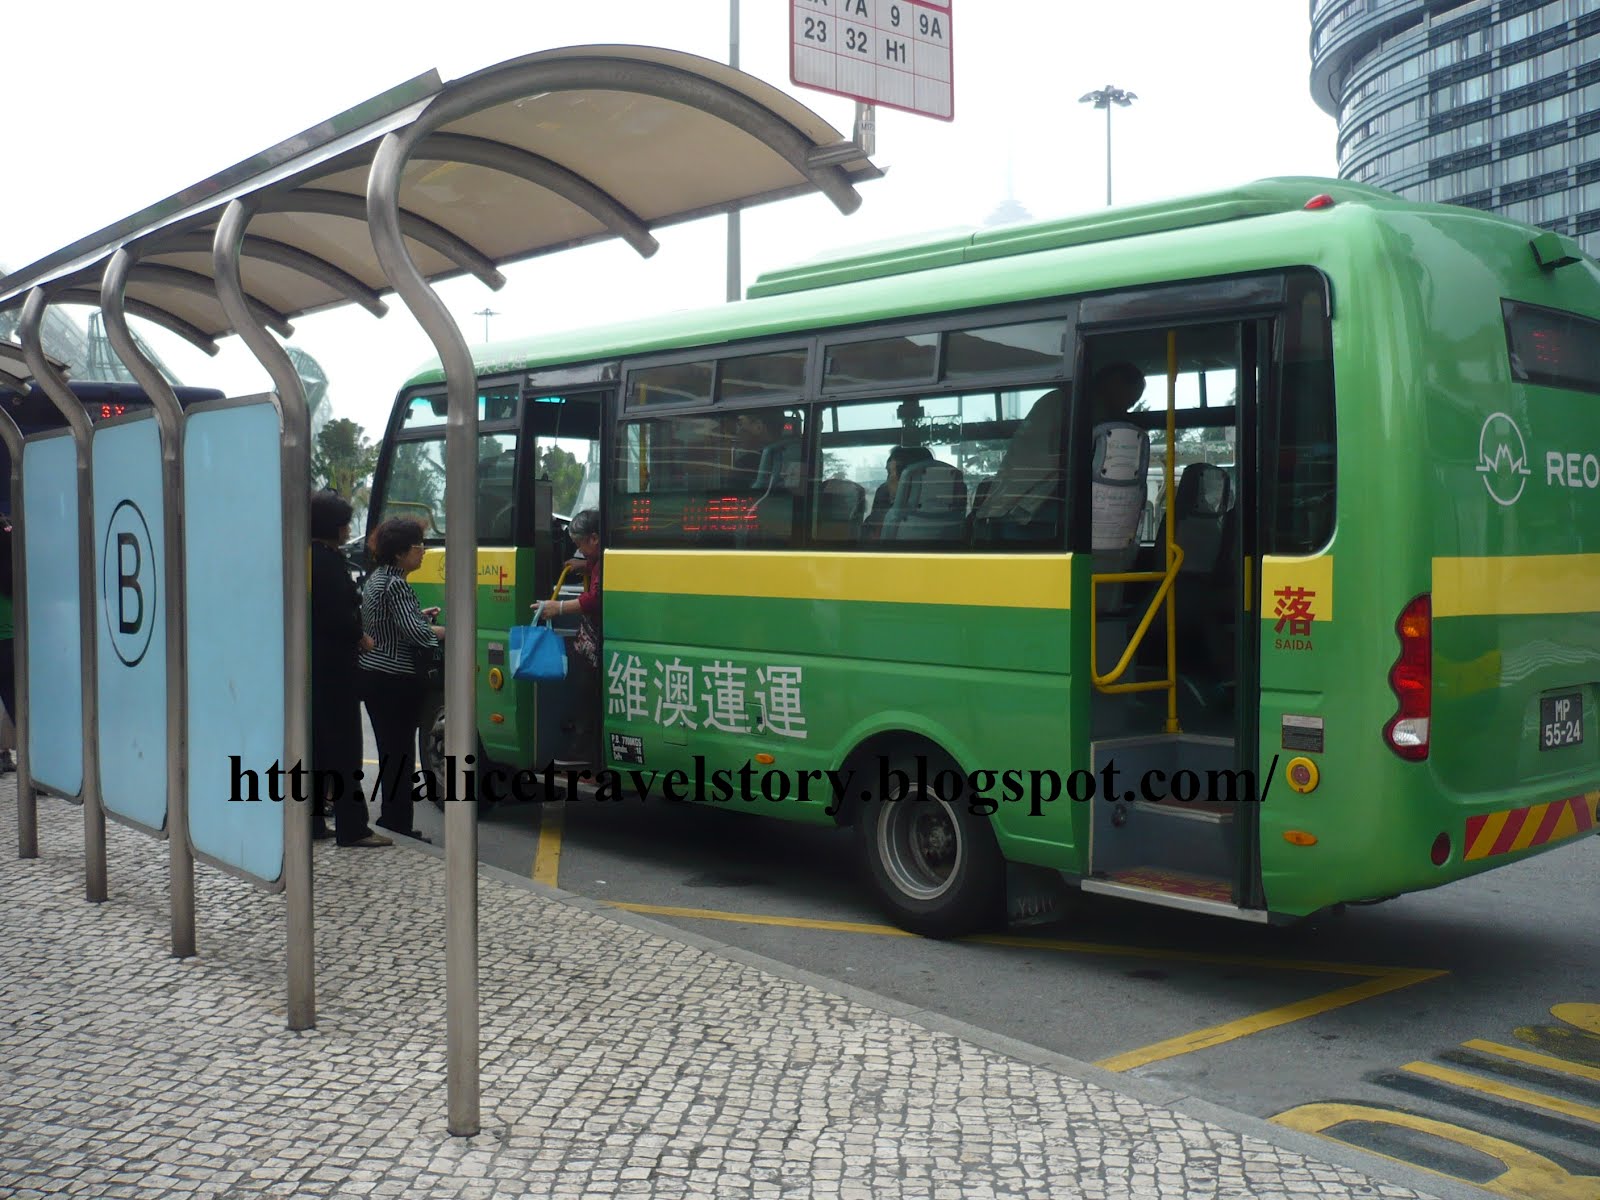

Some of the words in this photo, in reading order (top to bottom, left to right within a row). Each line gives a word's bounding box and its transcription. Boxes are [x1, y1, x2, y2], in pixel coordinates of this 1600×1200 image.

[890, 5, 901, 27] 9
[919, 14, 942, 39] 9A
[804, 17, 827, 43] 23
[845, 28, 868, 53] 32
[886, 39, 906, 64] H1
[1546, 451, 1600, 488] REO
[117, 532, 144, 634] B
[493, 566, 510, 593] 上
[1273, 586, 1316, 636] 落
[1274, 639, 1313, 651] SAIDA
[607, 651, 808, 739] 維澳蓮運
[1555, 699, 1570, 722] MP
[1545, 720, 1581, 746] 55-24
